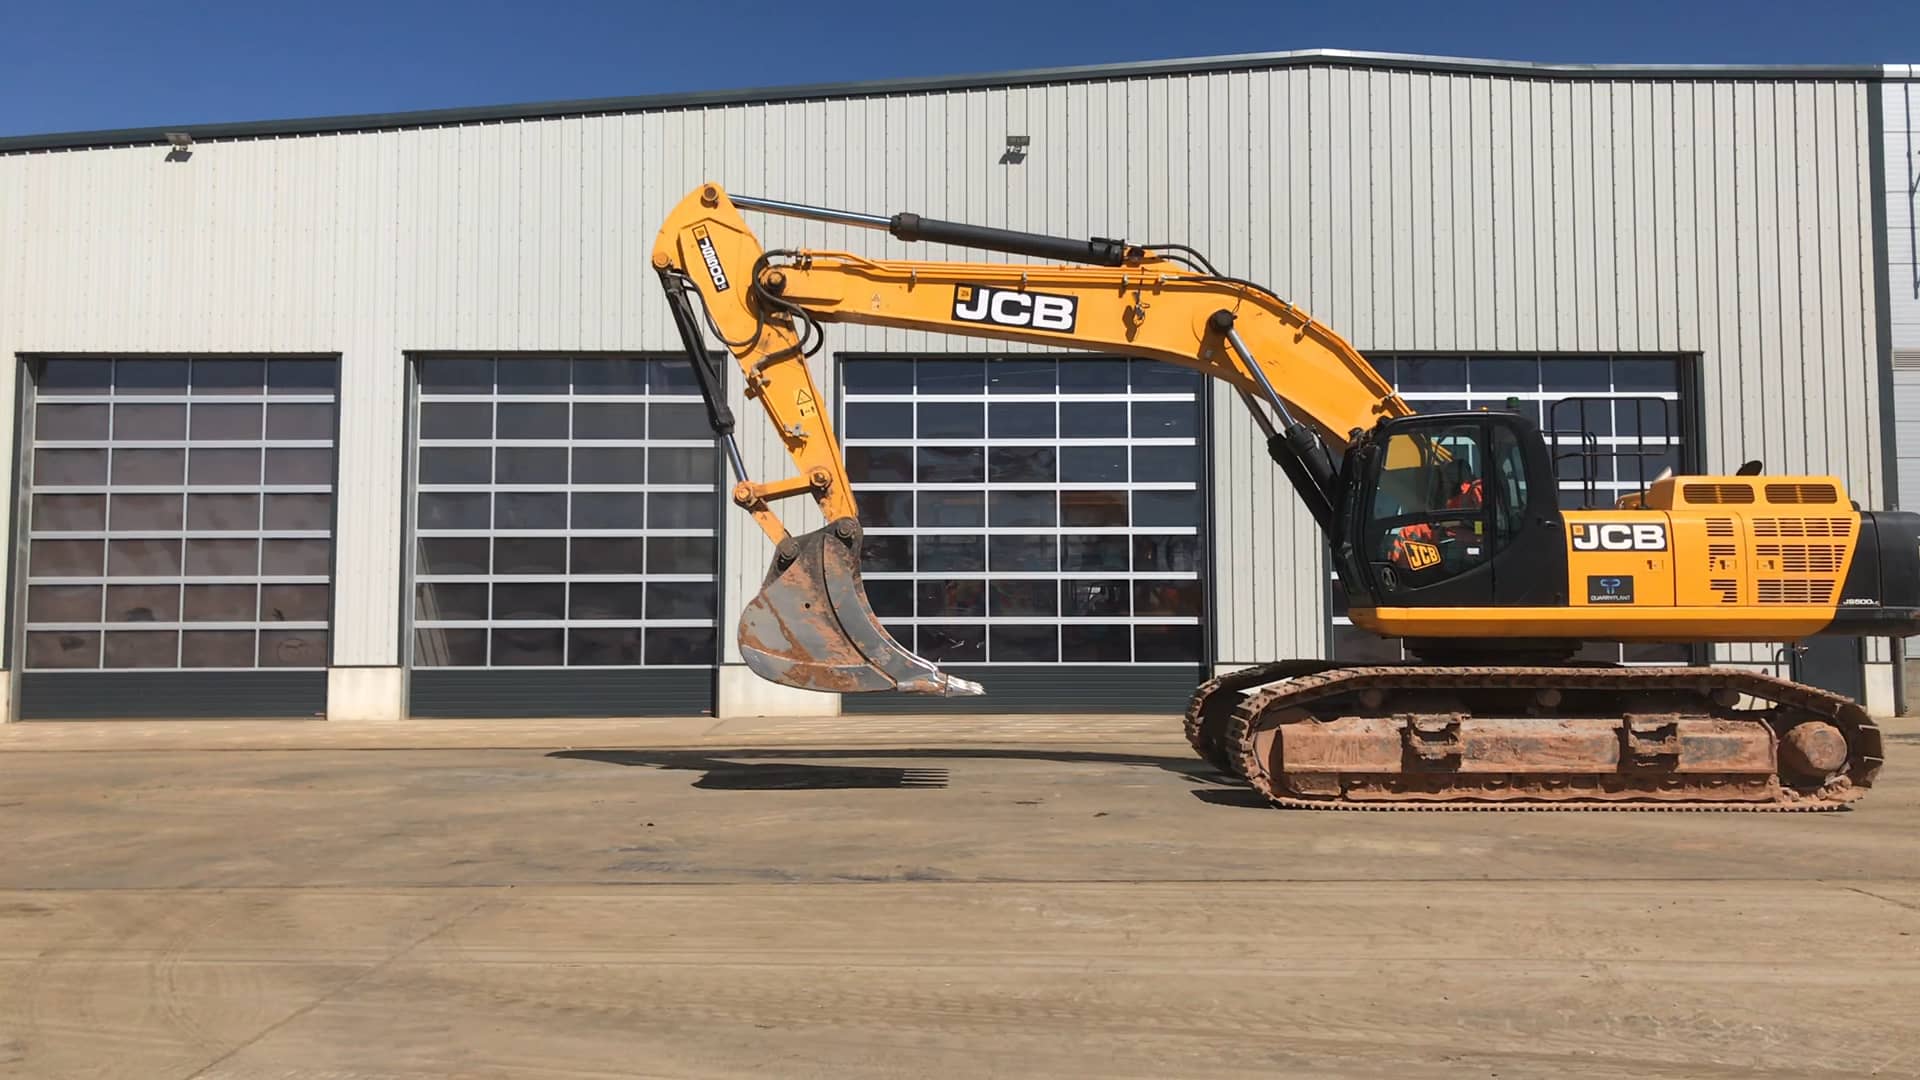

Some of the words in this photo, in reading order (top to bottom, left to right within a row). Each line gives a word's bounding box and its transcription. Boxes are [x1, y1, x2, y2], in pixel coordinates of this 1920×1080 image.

[955, 288, 1074, 330] JCB
[1573, 524, 1665, 550] JCB
[1410, 544, 1439, 567] JCB
